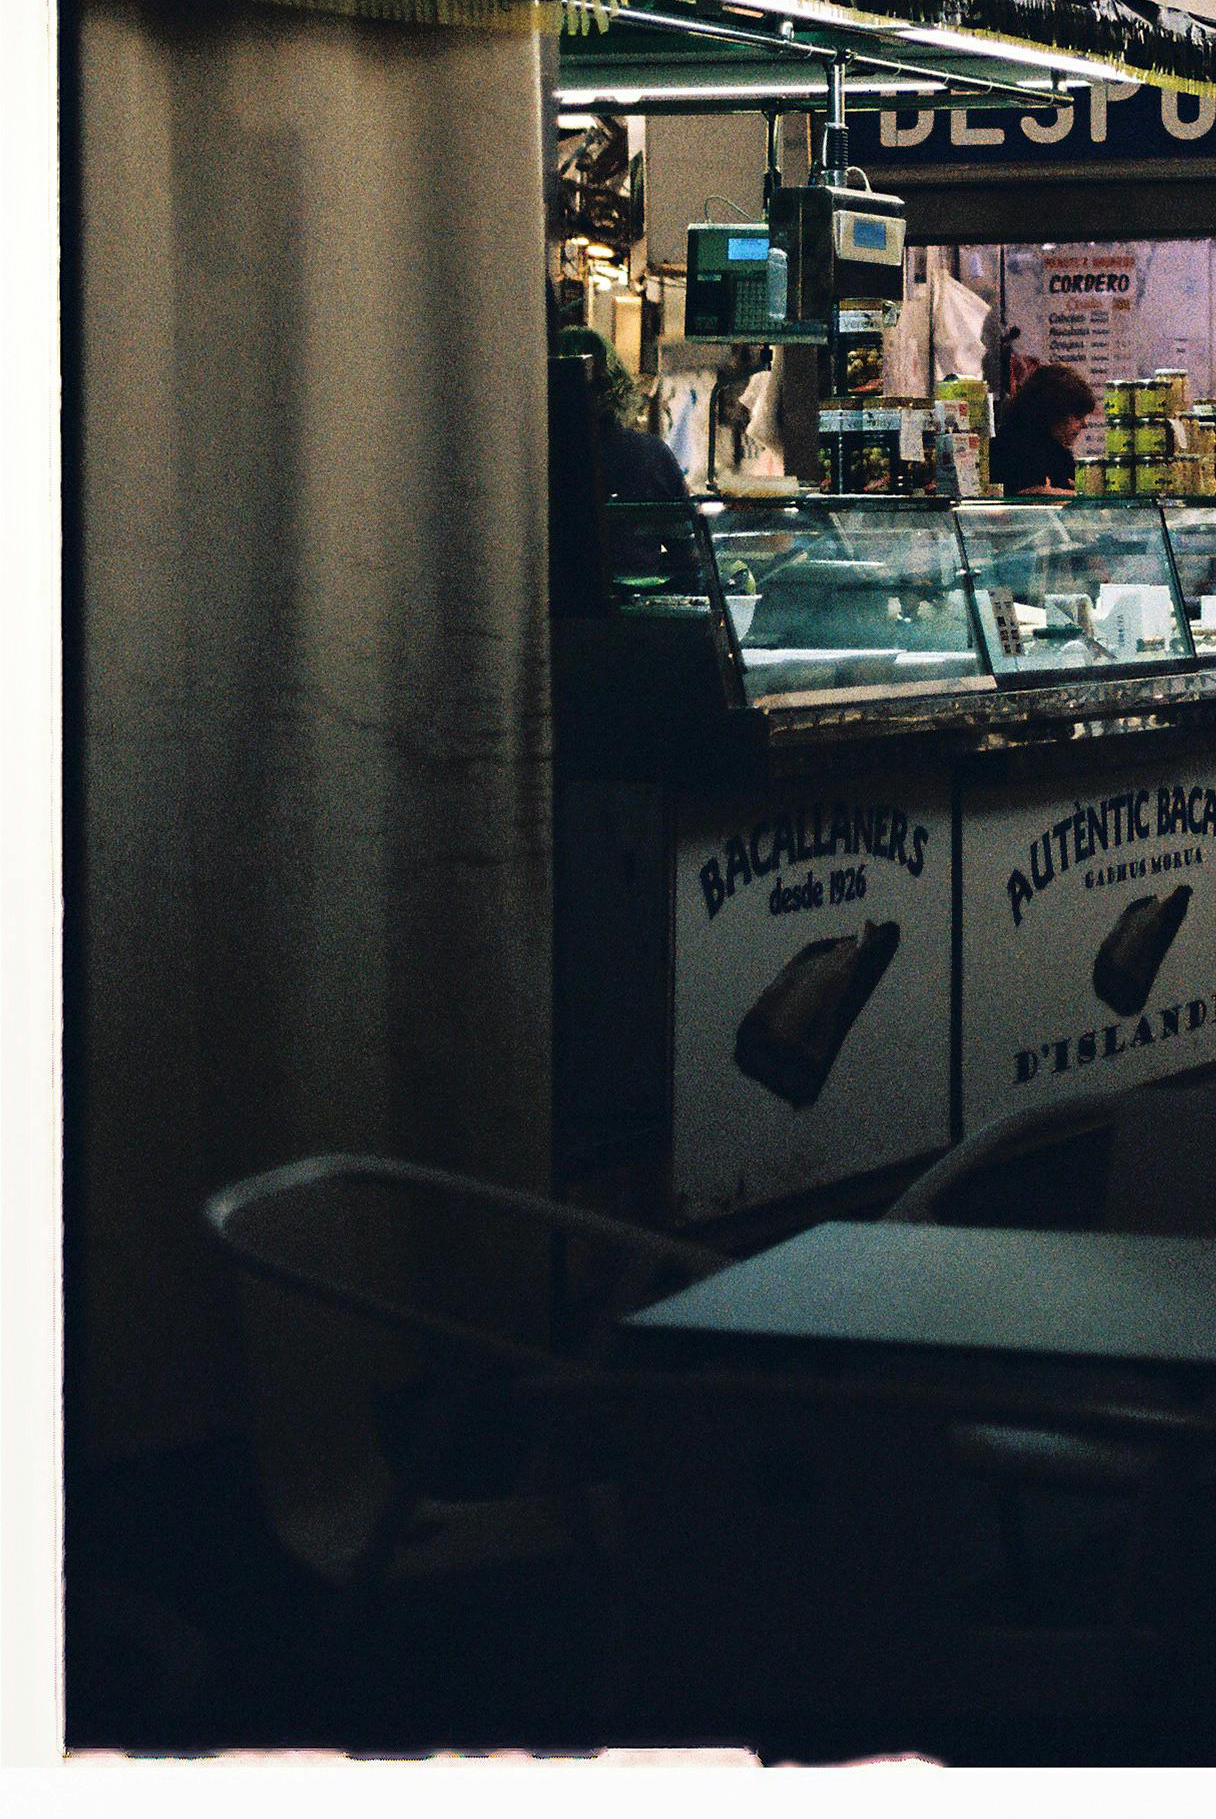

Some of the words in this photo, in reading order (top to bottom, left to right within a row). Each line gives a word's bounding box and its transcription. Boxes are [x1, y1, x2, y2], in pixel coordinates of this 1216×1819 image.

[1050, 273, 1130, 294] CORDERO
[700, 804, 929, 920] BACALLANERS
[769, 870, 823, 915] desde
[830, 864, 867, 905] 1926
[1007, 789, 1150, 927] AUTÈNTIC
